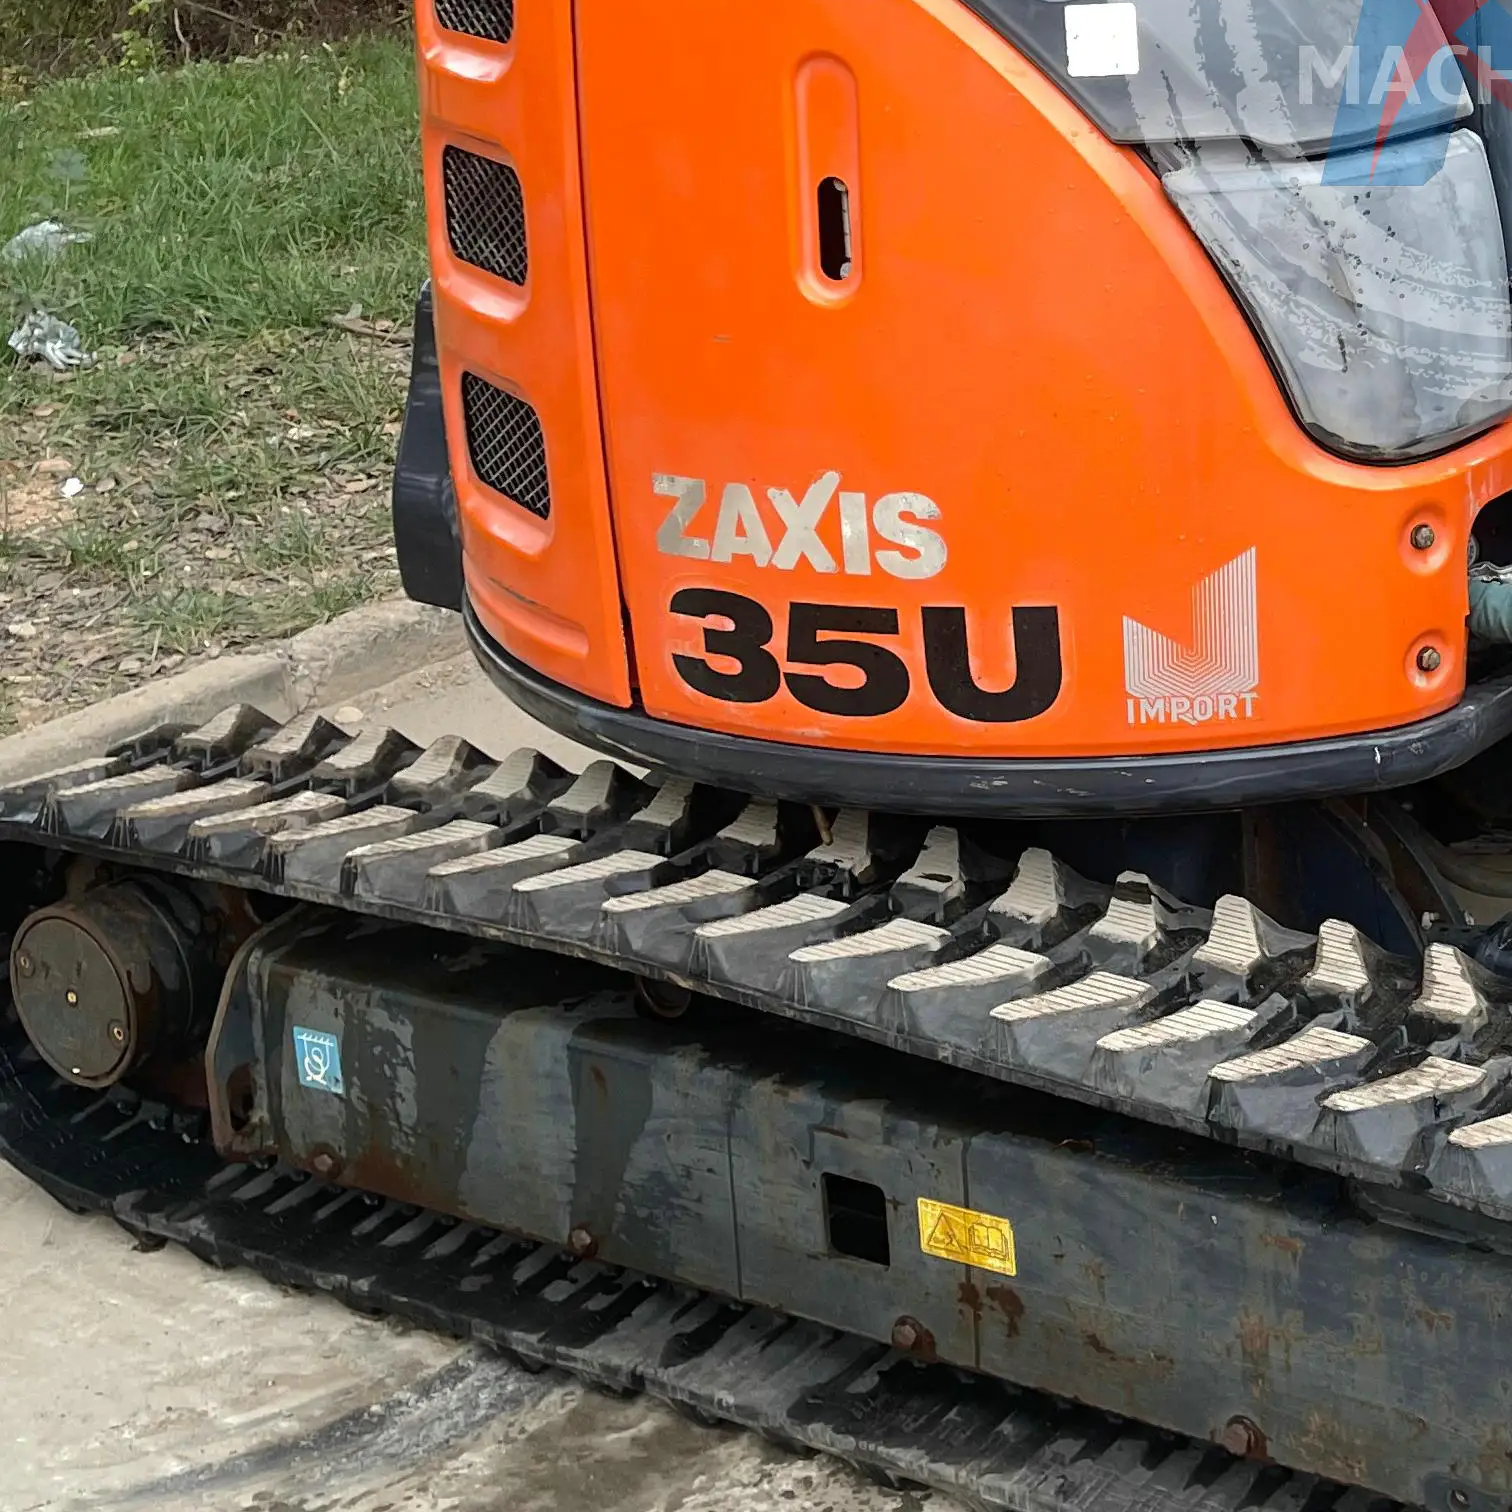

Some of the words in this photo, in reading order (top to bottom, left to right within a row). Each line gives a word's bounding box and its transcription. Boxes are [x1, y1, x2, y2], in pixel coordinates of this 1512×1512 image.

[652, 470, 948, 580] ZAXIS
[668, 588, 1064, 723] 35U
[1126, 692, 1260, 726] IMPORT
